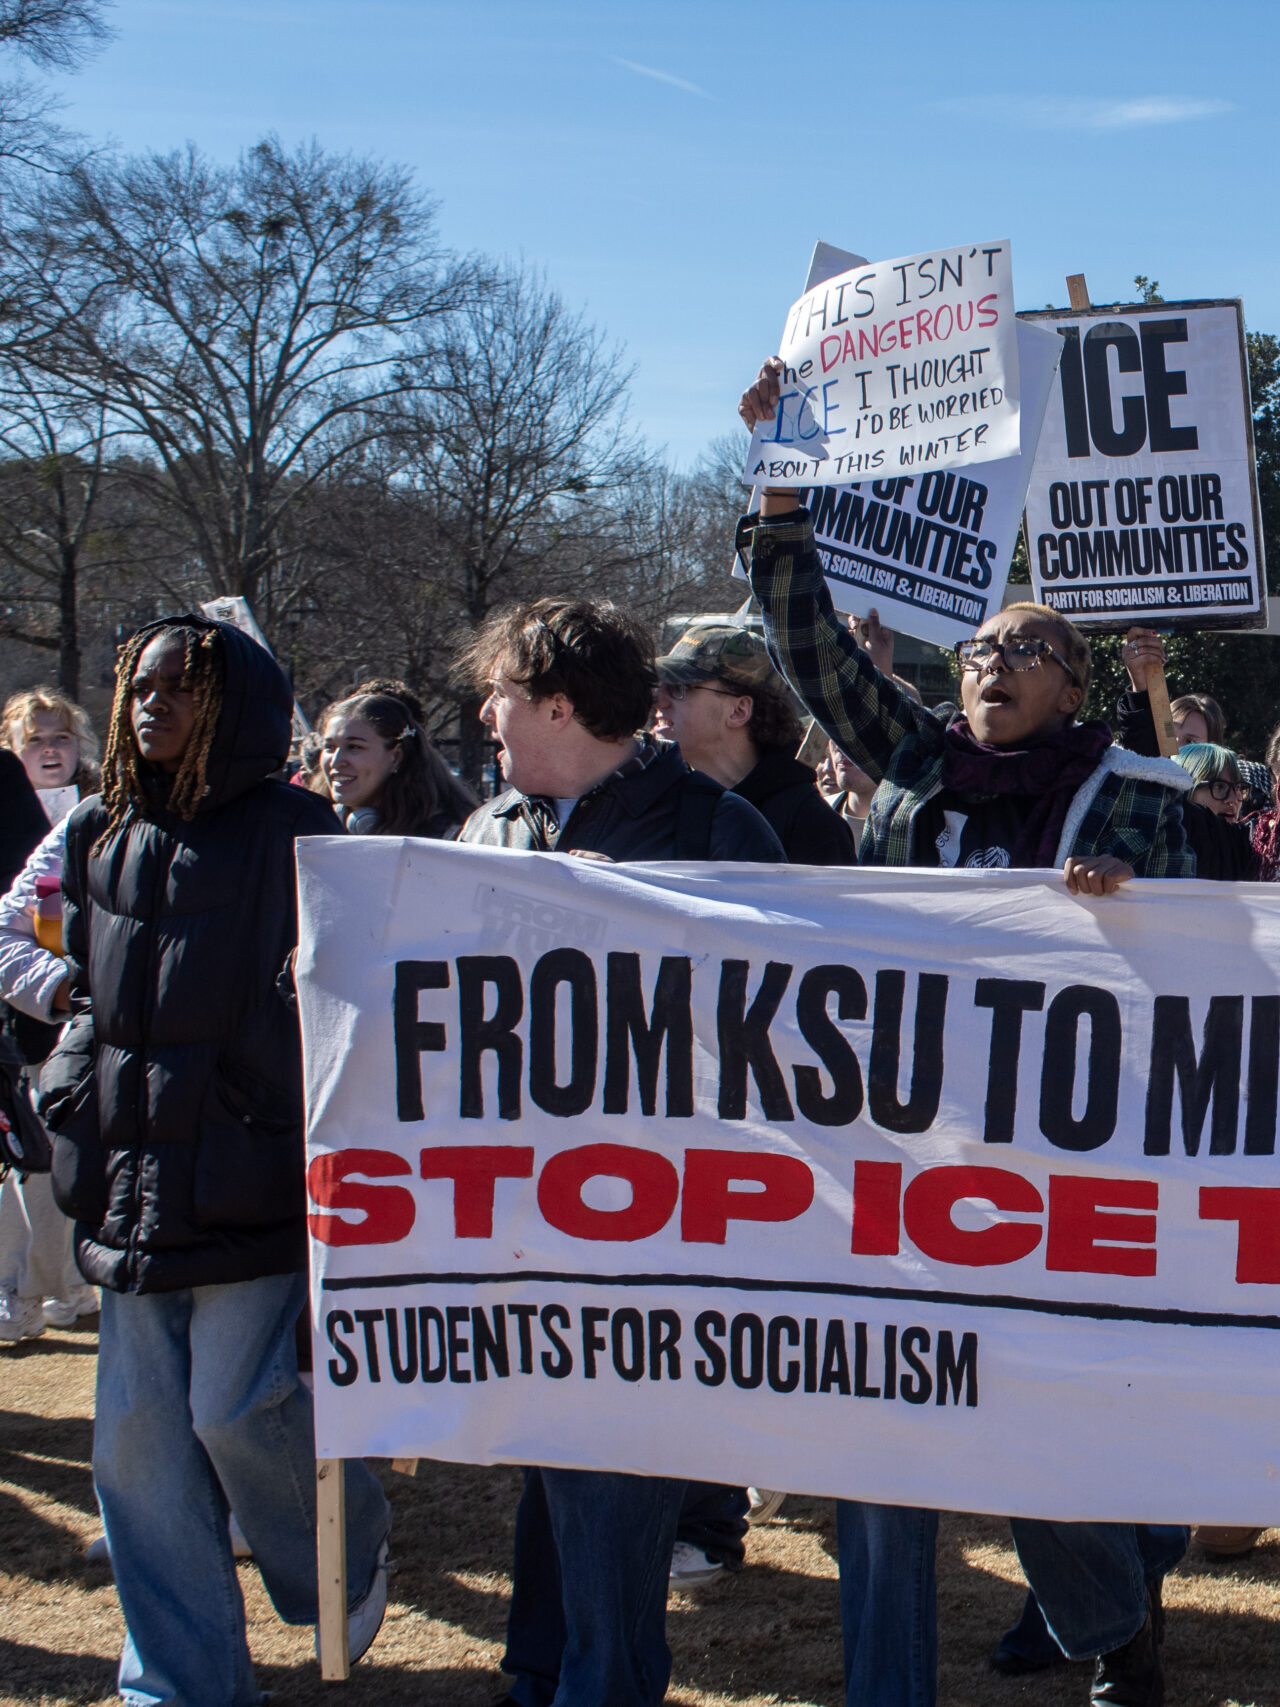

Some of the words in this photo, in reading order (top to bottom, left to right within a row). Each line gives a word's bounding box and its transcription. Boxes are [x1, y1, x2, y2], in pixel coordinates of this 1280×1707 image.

[791, 273, 876, 345] THIS
[892, 248, 1002, 307] ISN'T
[819, 293, 999, 374] DANGEROUS
[760, 379, 847, 443] ICE
[855, 371, 873, 411] I
[886, 348, 991, 399] THOUGHT
[855, 414, 883, 439] I'D
[889, 404, 913, 431] BE
[918, 388, 1003, 424] WORRIED
[1056, 317, 1199, 459] ICE
[753, 457, 825, 479] ABOUT
[834, 450, 885, 475] THIS
[900, 424, 989, 466] WINTER
[801, 486, 998, 590] OMMUNITIES
[917, 470, 988, 533] OUR
[1049, 479, 1110, 530] OUT
[1114, 477, 1153, 526] OF
[1158, 473, 1224, 524] OUR
[830, 552, 897, 593] SOCIALISM
[896, 577, 913, 598] &
[913, 581, 983, 621] LIBERATION
[1037, 522, 1249, 581] COMMUNITIES
[1044, 590, 1081, 610] PARTY
[1082, 589, 1104, 608] FOR
[1105, 586, 1166, 606] SOCIALISM
[1167, 586, 1183, 604] &
[1183, 582, 1249, 602] LIBERATION
[394, 947, 694, 1121] FROM
[716, 960, 949, 1134] KSU
[974, 977, 1122, 1153] TO
[308, 1142, 815, 1248] STOP
[850, 1159, 1160, 1278] ICE
[325, 1302, 573, 1388] STUDENTS
[582, 1307, 682, 1382] FOR
[694, 1309, 979, 1408] SOCIALISM
